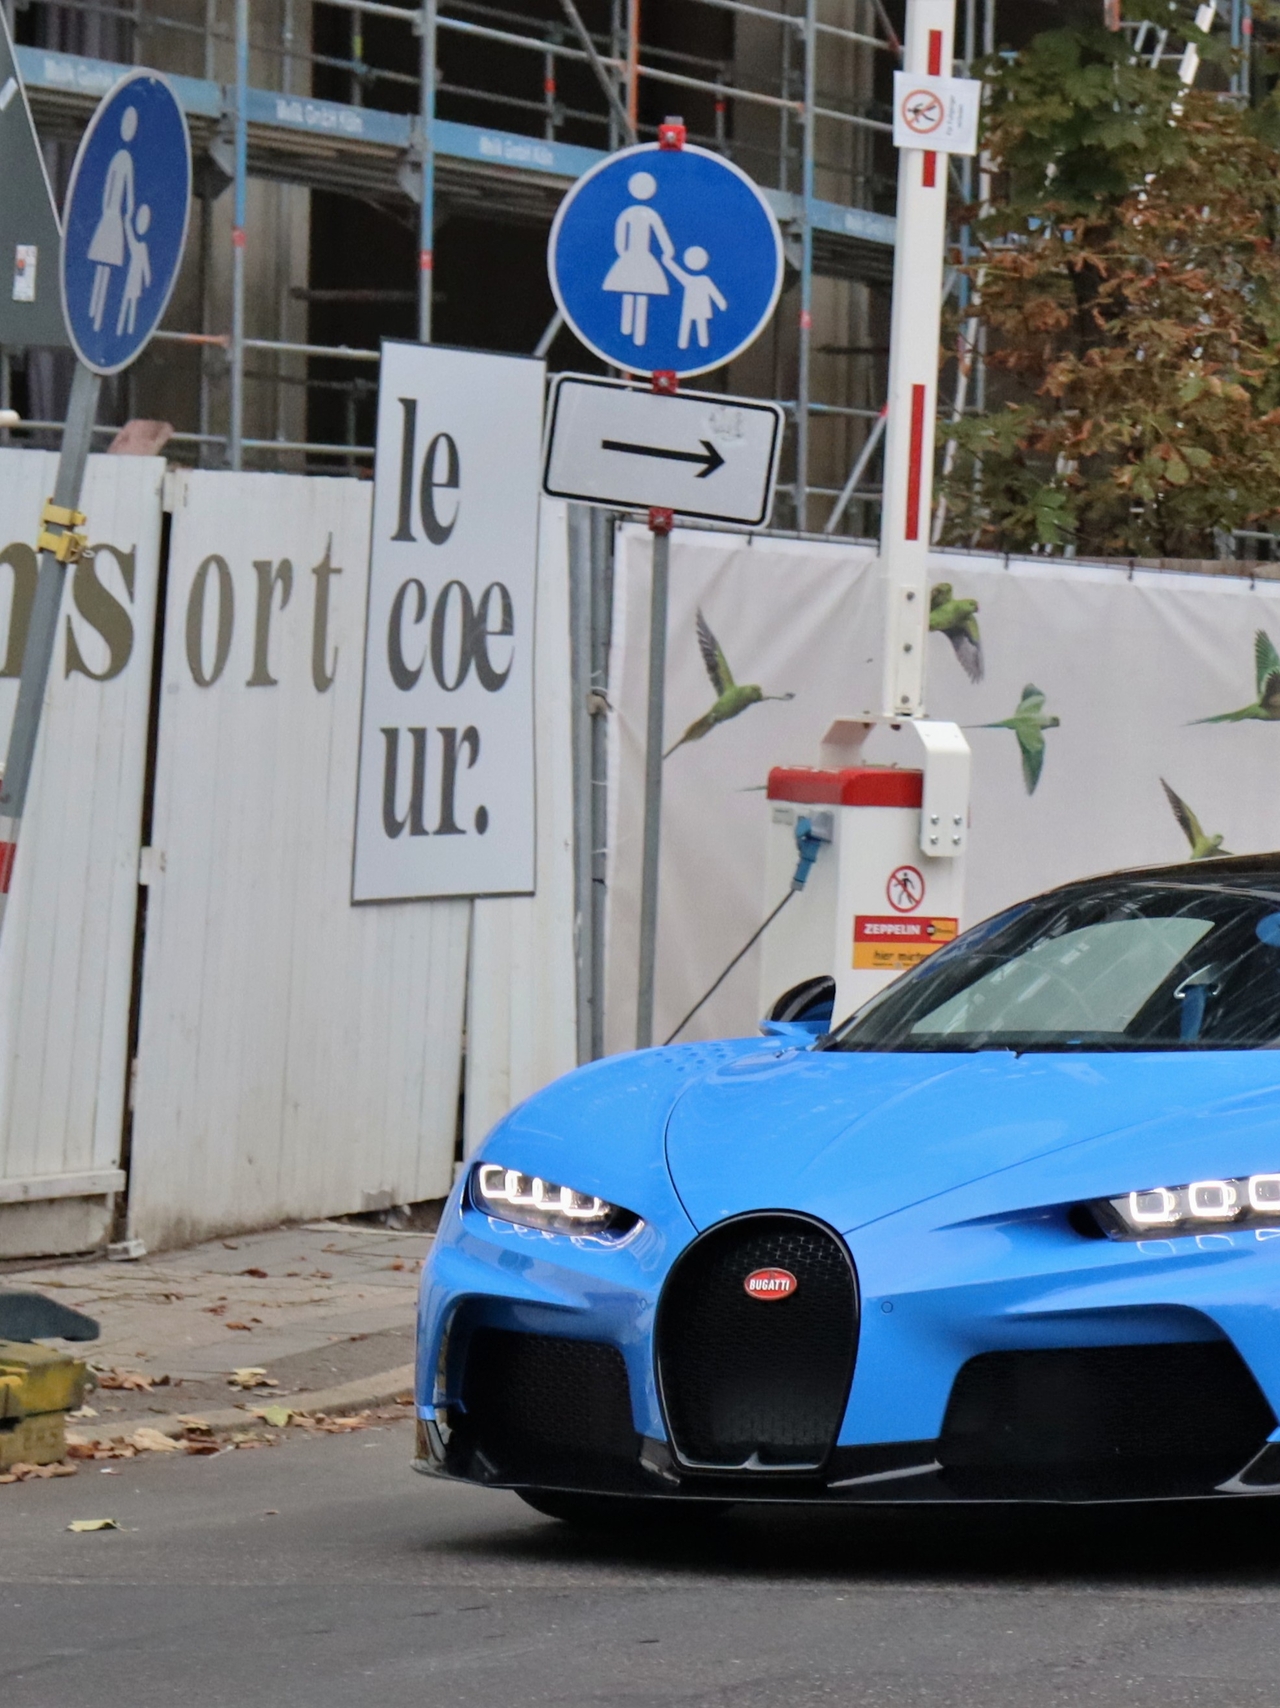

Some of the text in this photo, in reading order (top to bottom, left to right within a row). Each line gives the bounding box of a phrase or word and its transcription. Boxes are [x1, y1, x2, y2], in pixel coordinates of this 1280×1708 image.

[390, 397, 460, 545] le
[379, 725, 489, 839] ur.
[864, 924, 921, 935] ZEPPELIN
[749, 1278, 791, 1292] BUGATTI
